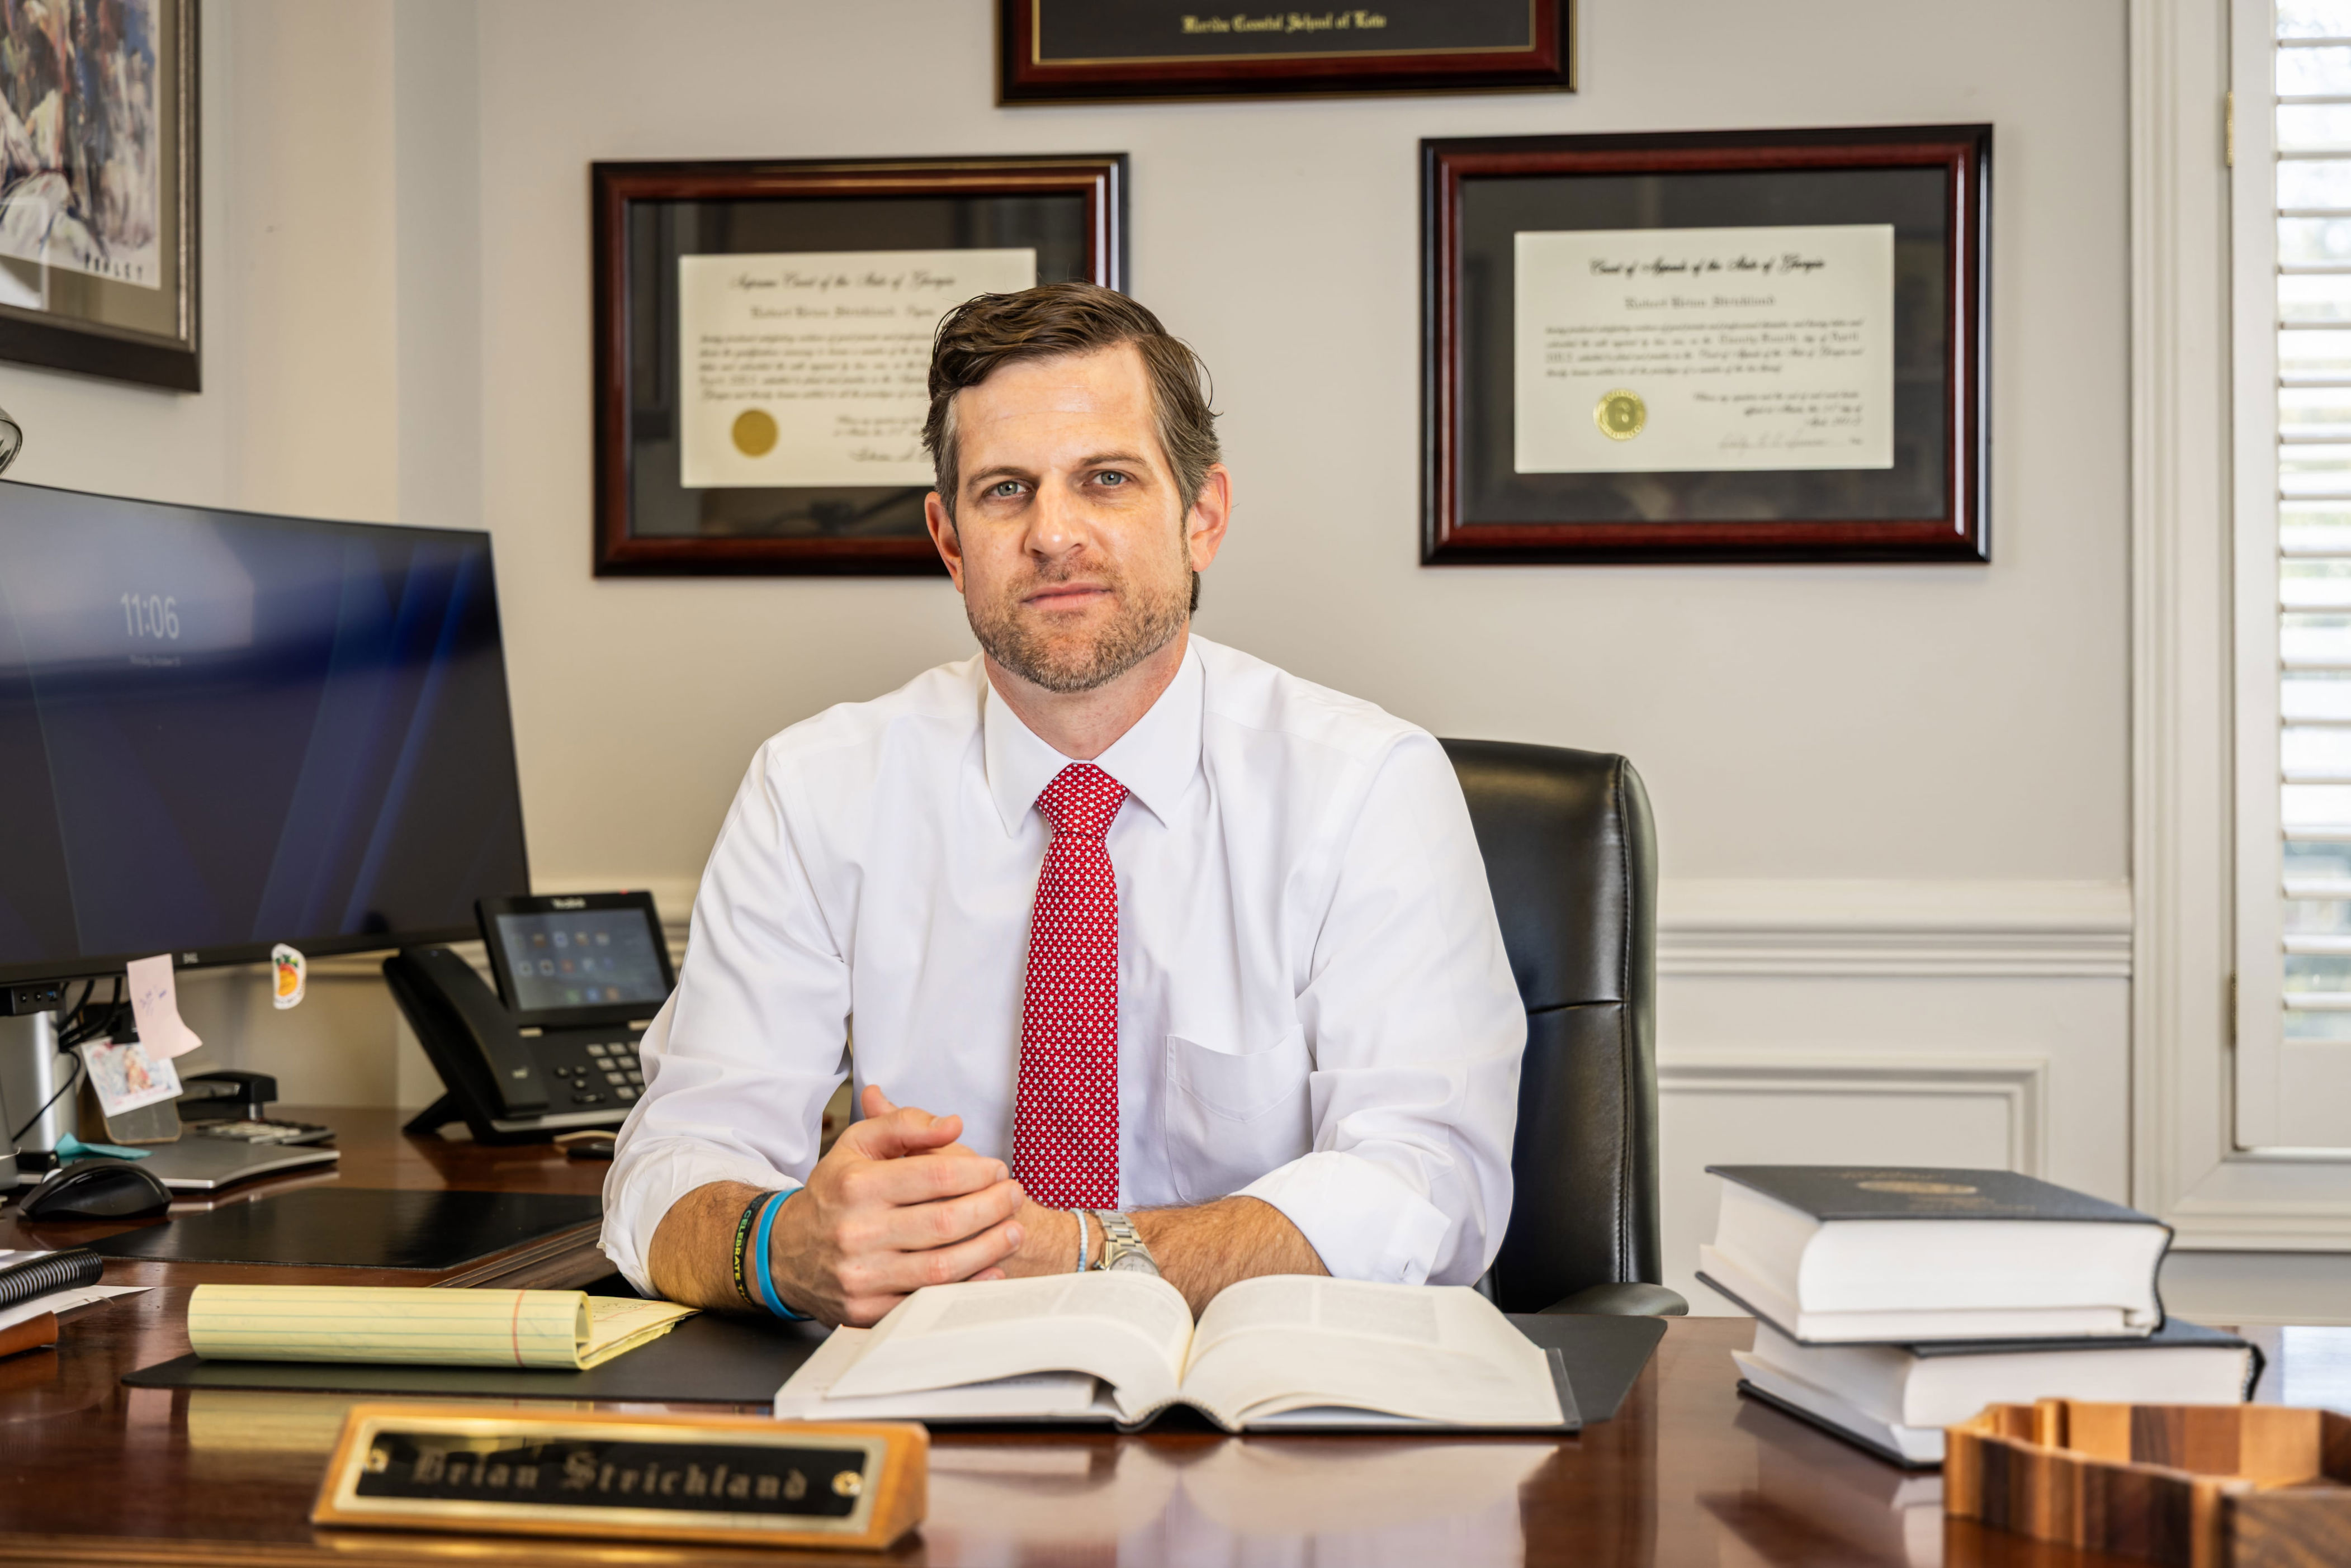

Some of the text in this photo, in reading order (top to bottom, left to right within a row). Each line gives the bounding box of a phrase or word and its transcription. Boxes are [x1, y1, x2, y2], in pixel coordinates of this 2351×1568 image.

[121, 591, 179, 640] 11:06
[734, 1209, 752, 1281] CELEBRATE
[414, 1447, 540, 1489] Brian
